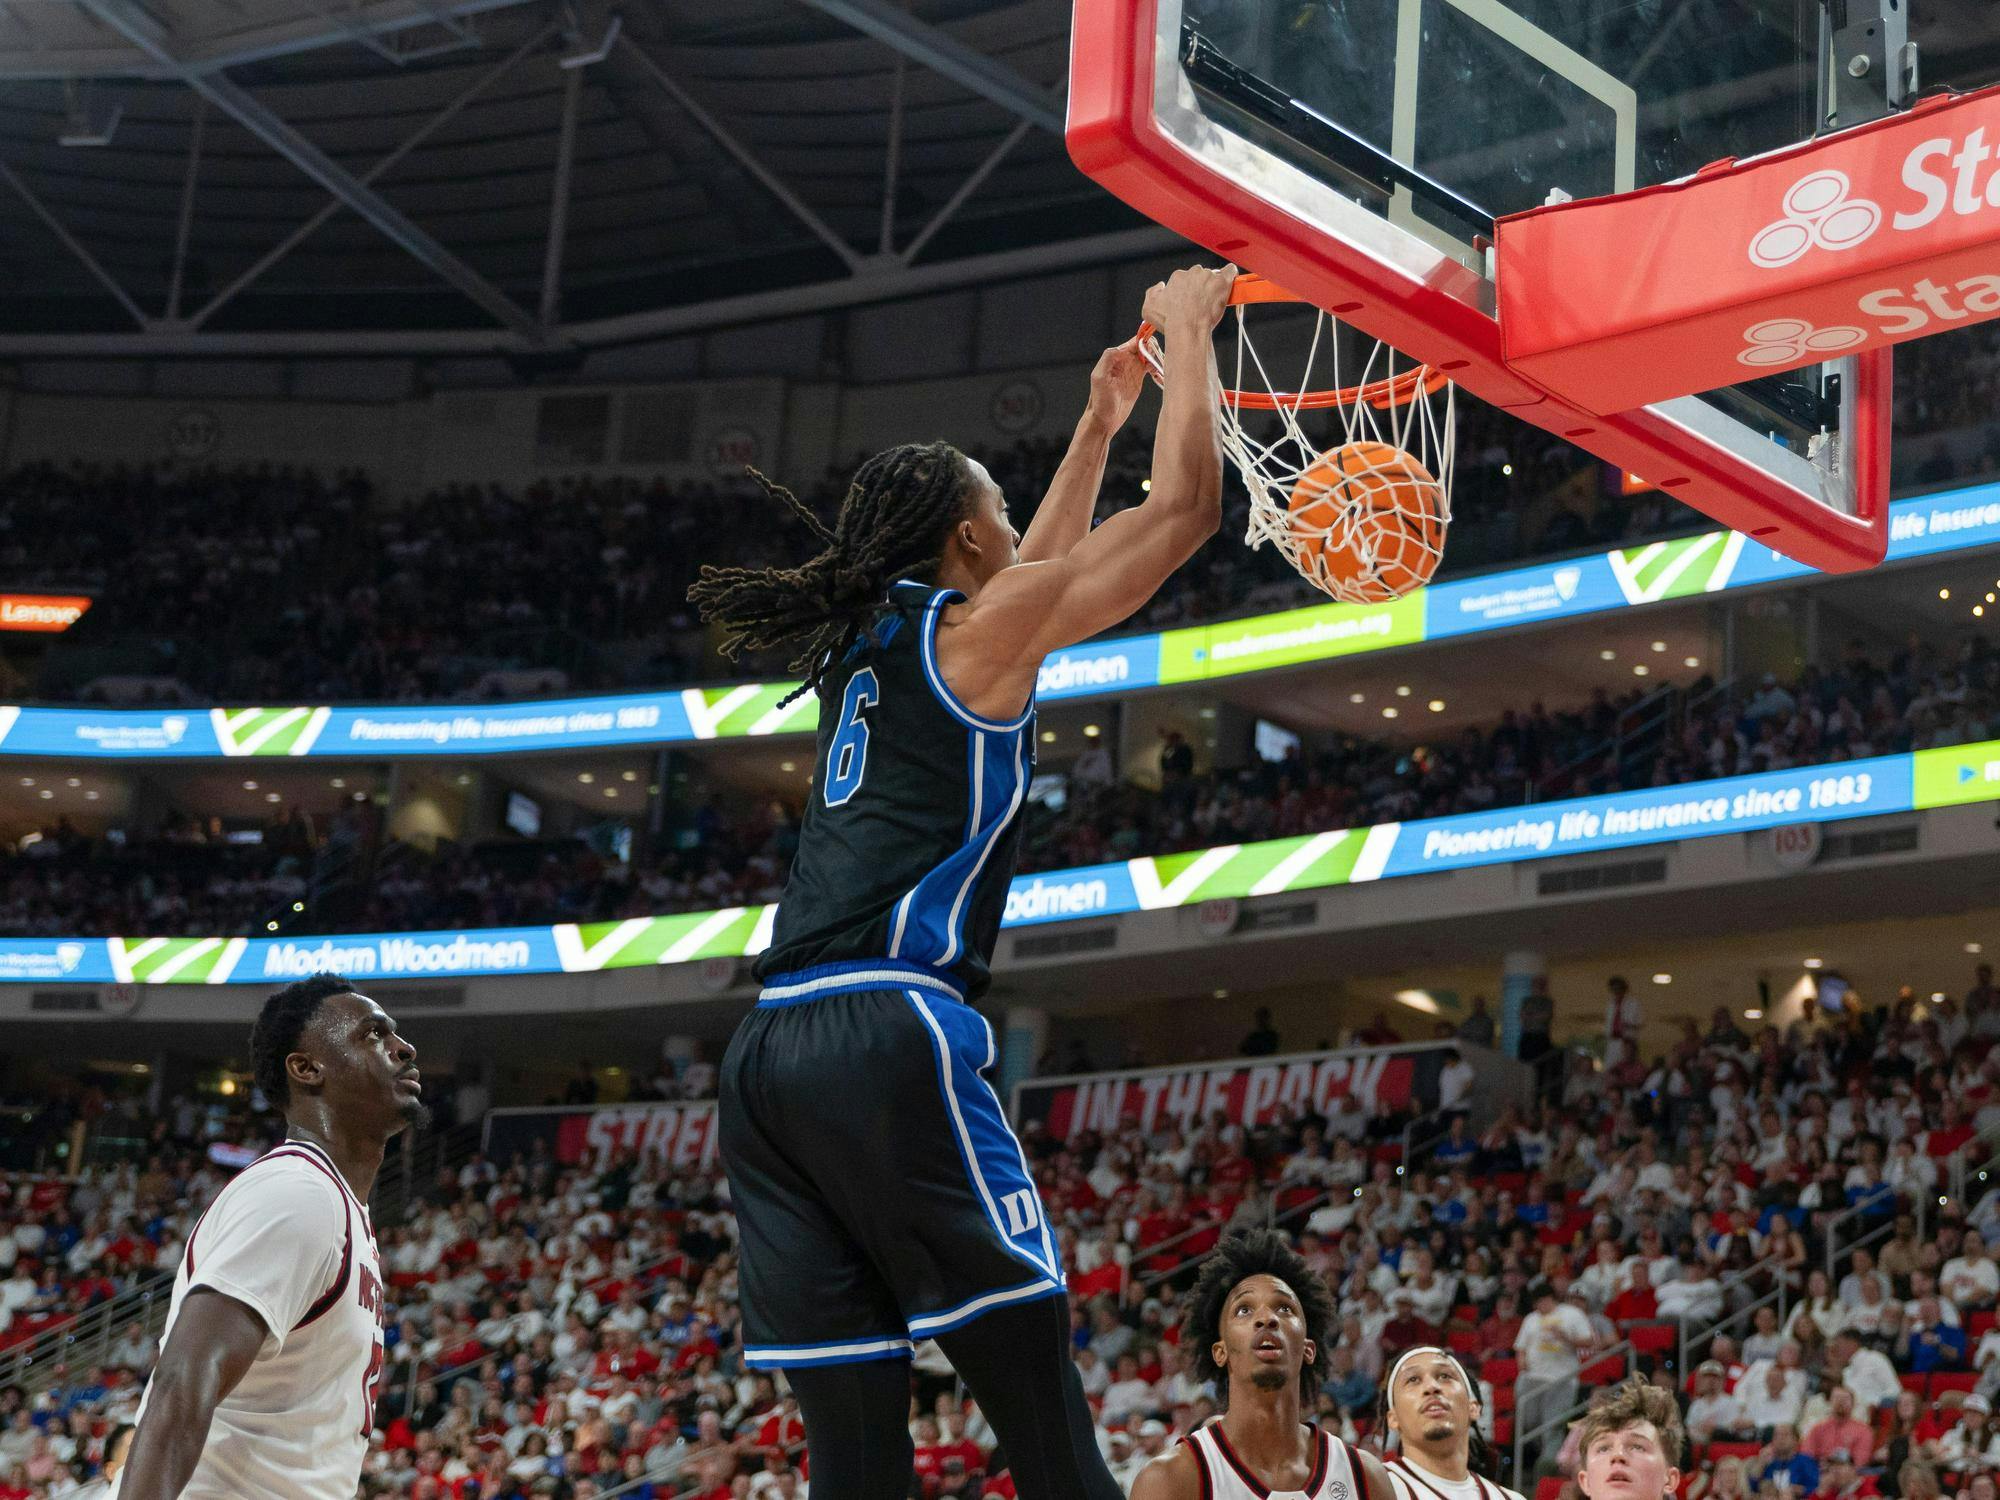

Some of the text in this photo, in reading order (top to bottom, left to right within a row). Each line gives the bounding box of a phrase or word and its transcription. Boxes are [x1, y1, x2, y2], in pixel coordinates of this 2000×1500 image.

[1858, 274, 2000, 334] Sta
[1891, 512, 1927, 541] life
[823, 666, 879, 808] 6
[1423, 773, 1872, 860] Pioneering life insurance since 1883
[264, 934, 530, 977] Modern Woodmen
[1066, 1053, 1392, 1146] IN THE PACK
[1000, 1188, 1038, 1237] D
